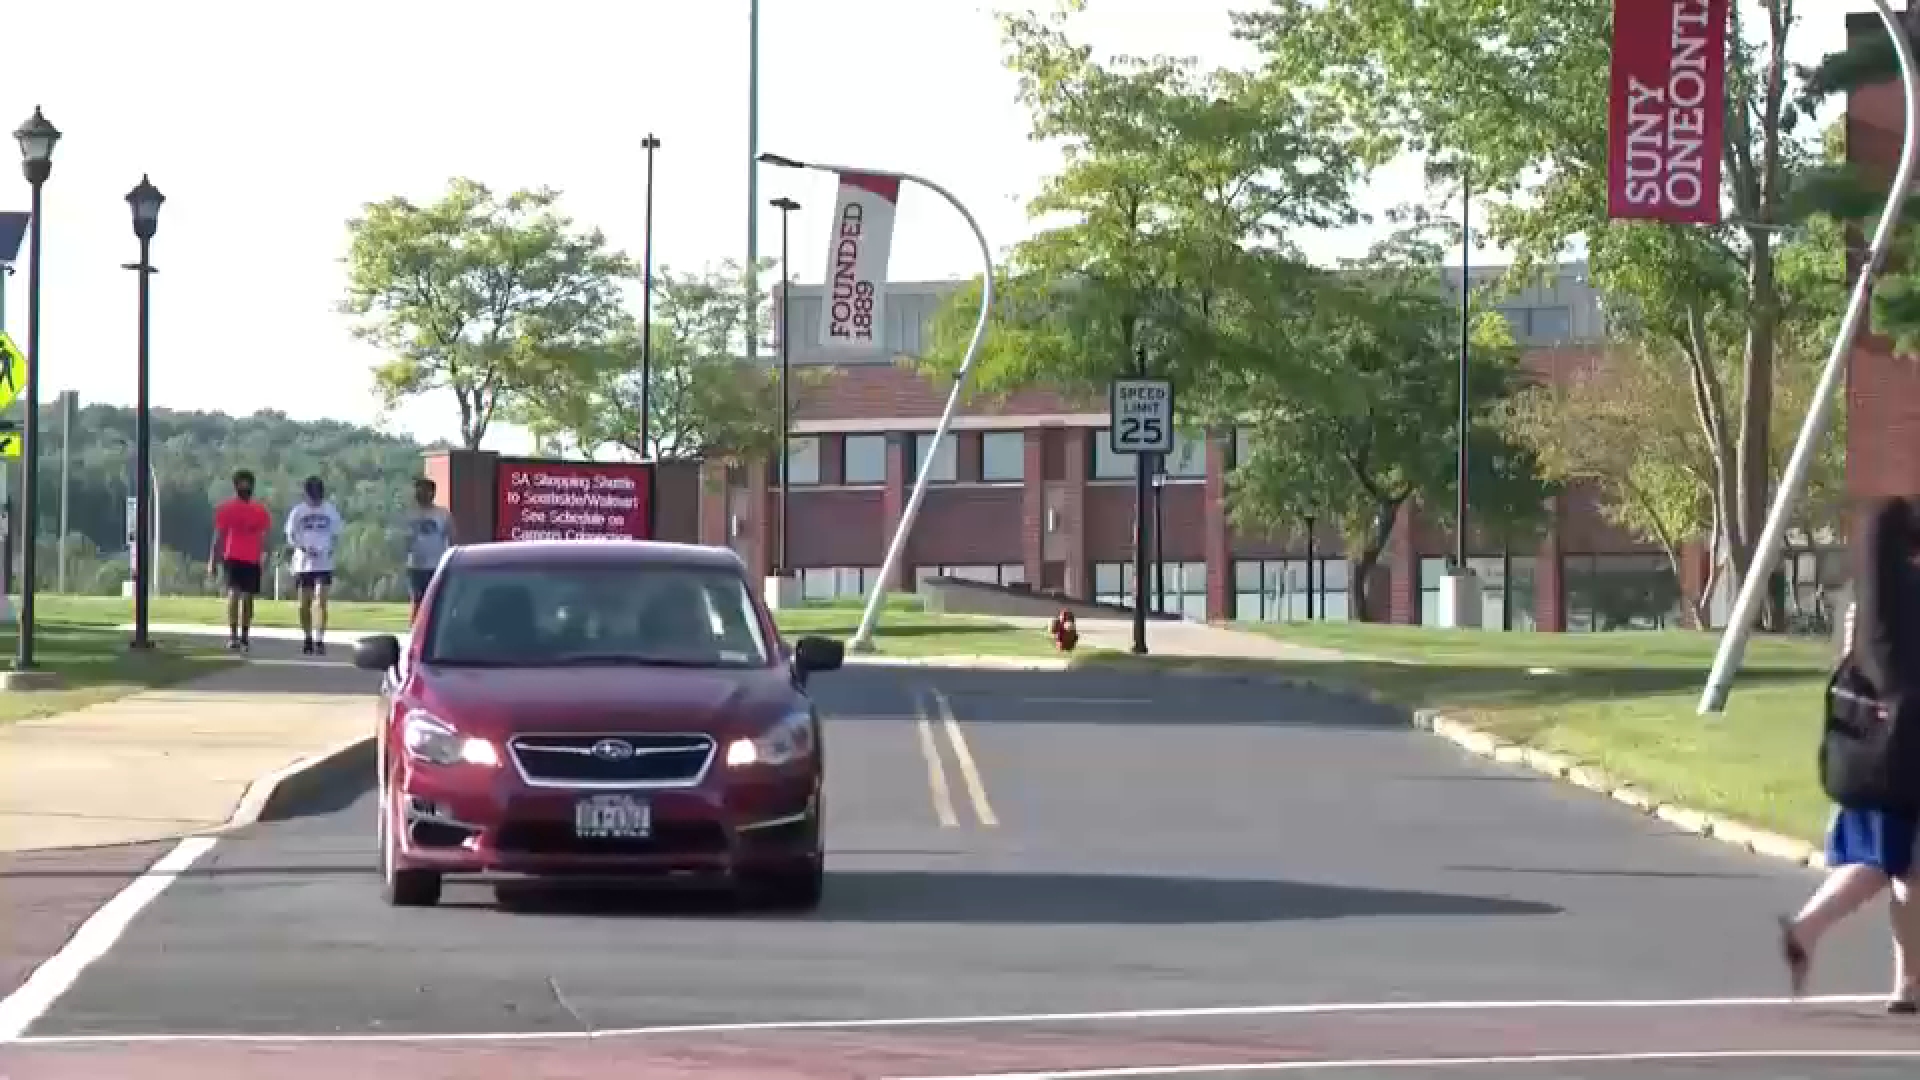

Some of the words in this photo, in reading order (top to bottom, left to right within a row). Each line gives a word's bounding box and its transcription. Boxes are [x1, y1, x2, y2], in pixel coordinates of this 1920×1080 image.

[1666, 0, 1708, 207] ONEONT
[1626, 75, 1664, 205] SUNY
[830, 202, 863, 337] FOUNDED
[854, 280, 874, 339] 1889
[1120, 388, 1165, 400] SPEED
[1124, 402, 1160, 415] LIMIT
[1120, 417, 1163, 444] 25
[511, 472, 530, 486] SA
[534, 473, 590, 490] Shopping
[593, 474, 637, 489] Shuttle
[507, 491, 521, 505] to
[523, 491, 639, 509] Southside/Walmart
[521, 508, 545, 523] See
[550, 510, 605, 525] Schedule
[607, 515, 625, 526] on
